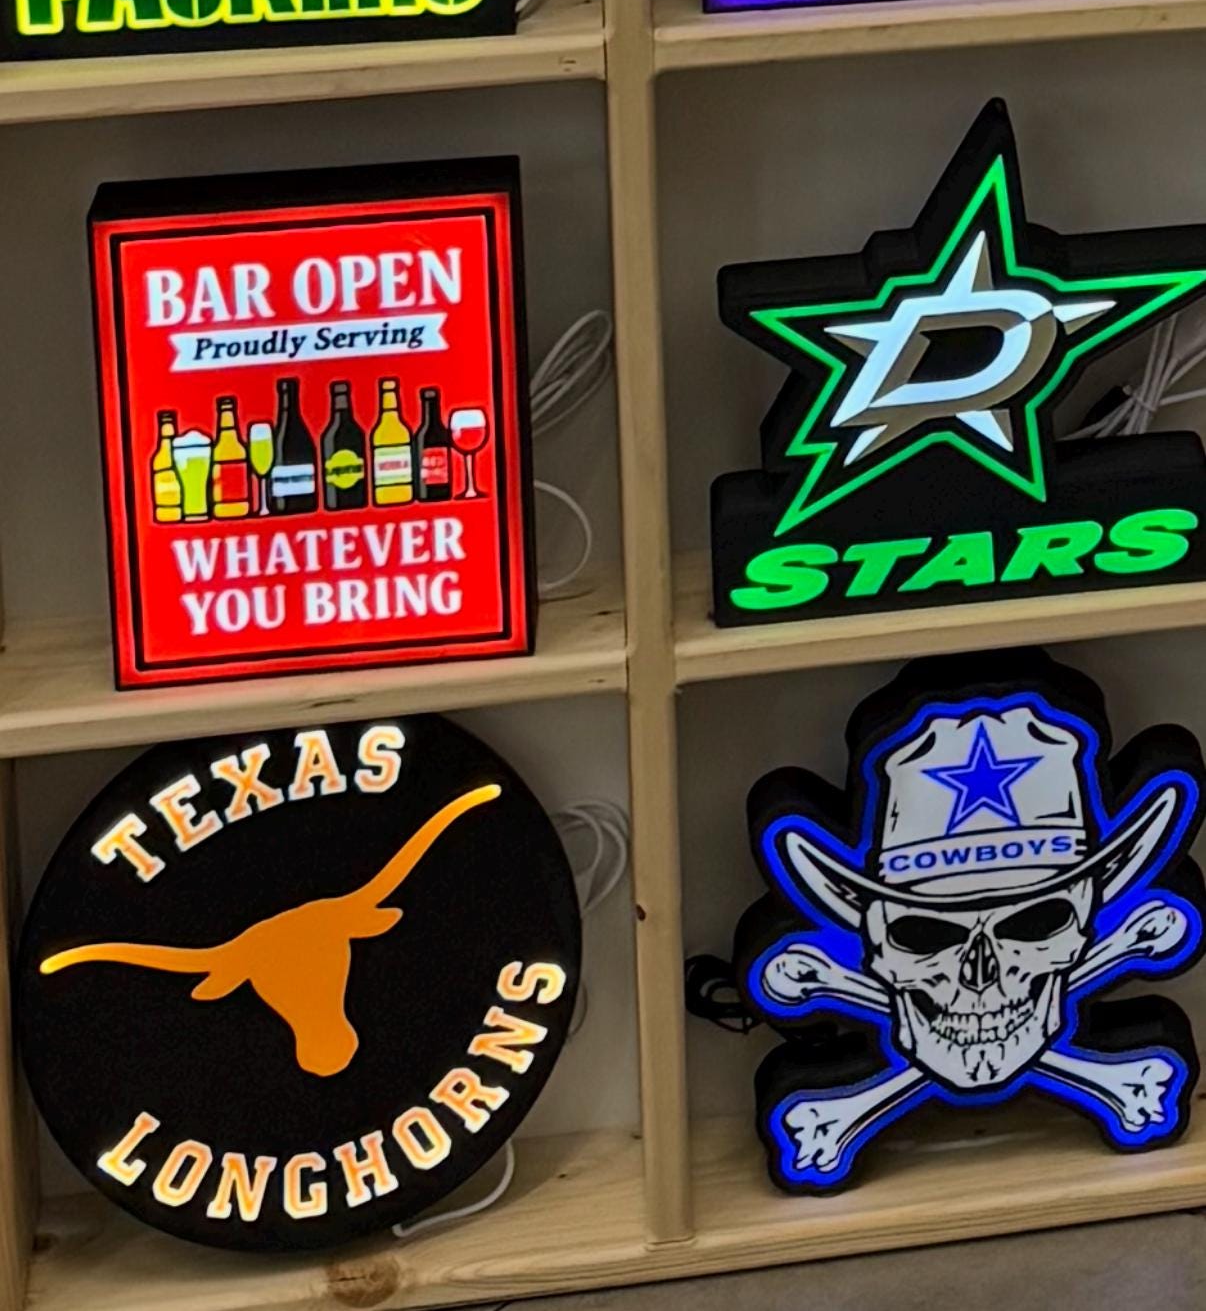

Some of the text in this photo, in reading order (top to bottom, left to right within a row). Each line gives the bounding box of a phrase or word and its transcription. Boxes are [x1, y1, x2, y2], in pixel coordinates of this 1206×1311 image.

[145, 247, 462, 327] BAR OPEN
[192, 322, 425, 361] Proudly Serving
[171, 517, 467, 584] WHATEVER
[730, 508, 1199, 610] STARS
[181, 571, 463, 636] YOU BRING
[91, 725, 406, 883] TEXAS
[888, 835, 1073, 873] COWBOYS
[97, 960, 567, 1222] LONGHORNS
